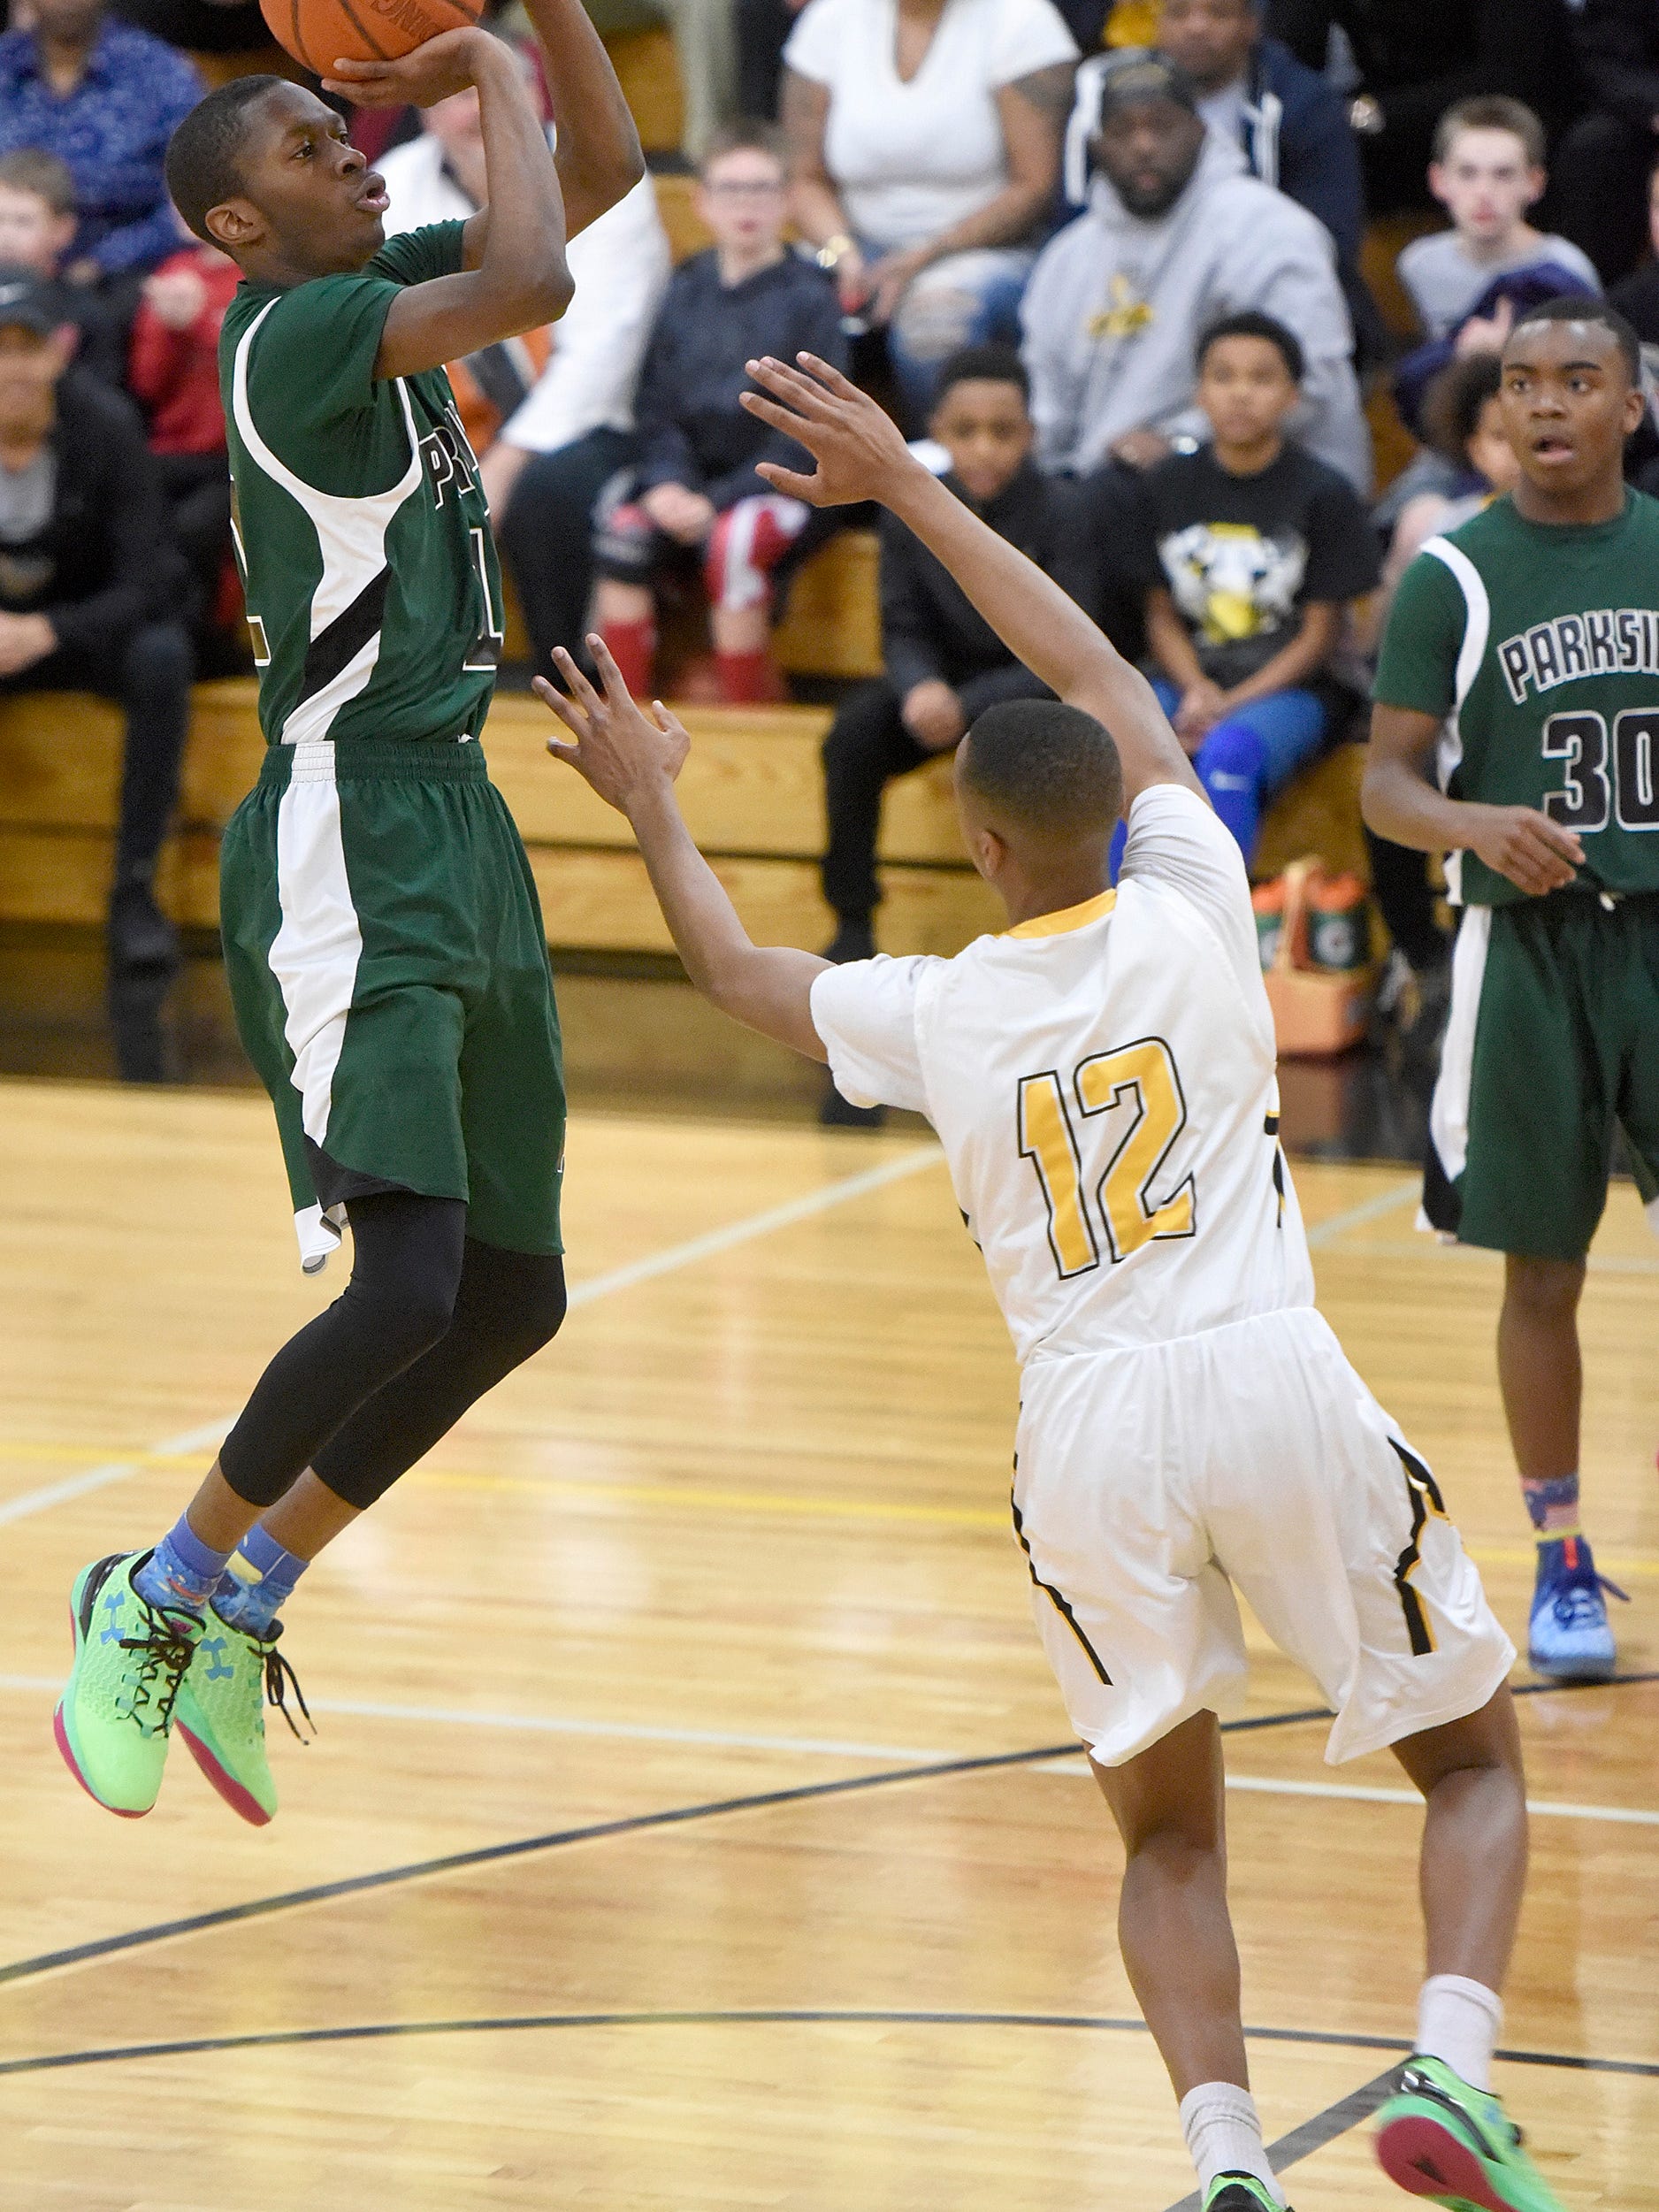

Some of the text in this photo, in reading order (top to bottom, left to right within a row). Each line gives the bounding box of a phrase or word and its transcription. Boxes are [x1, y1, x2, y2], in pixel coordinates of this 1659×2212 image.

[1497, 608, 1659, 704] PARKSI
[1542, 708, 1659, 832] 30
[1017, 1036, 1196, 1280] 12
